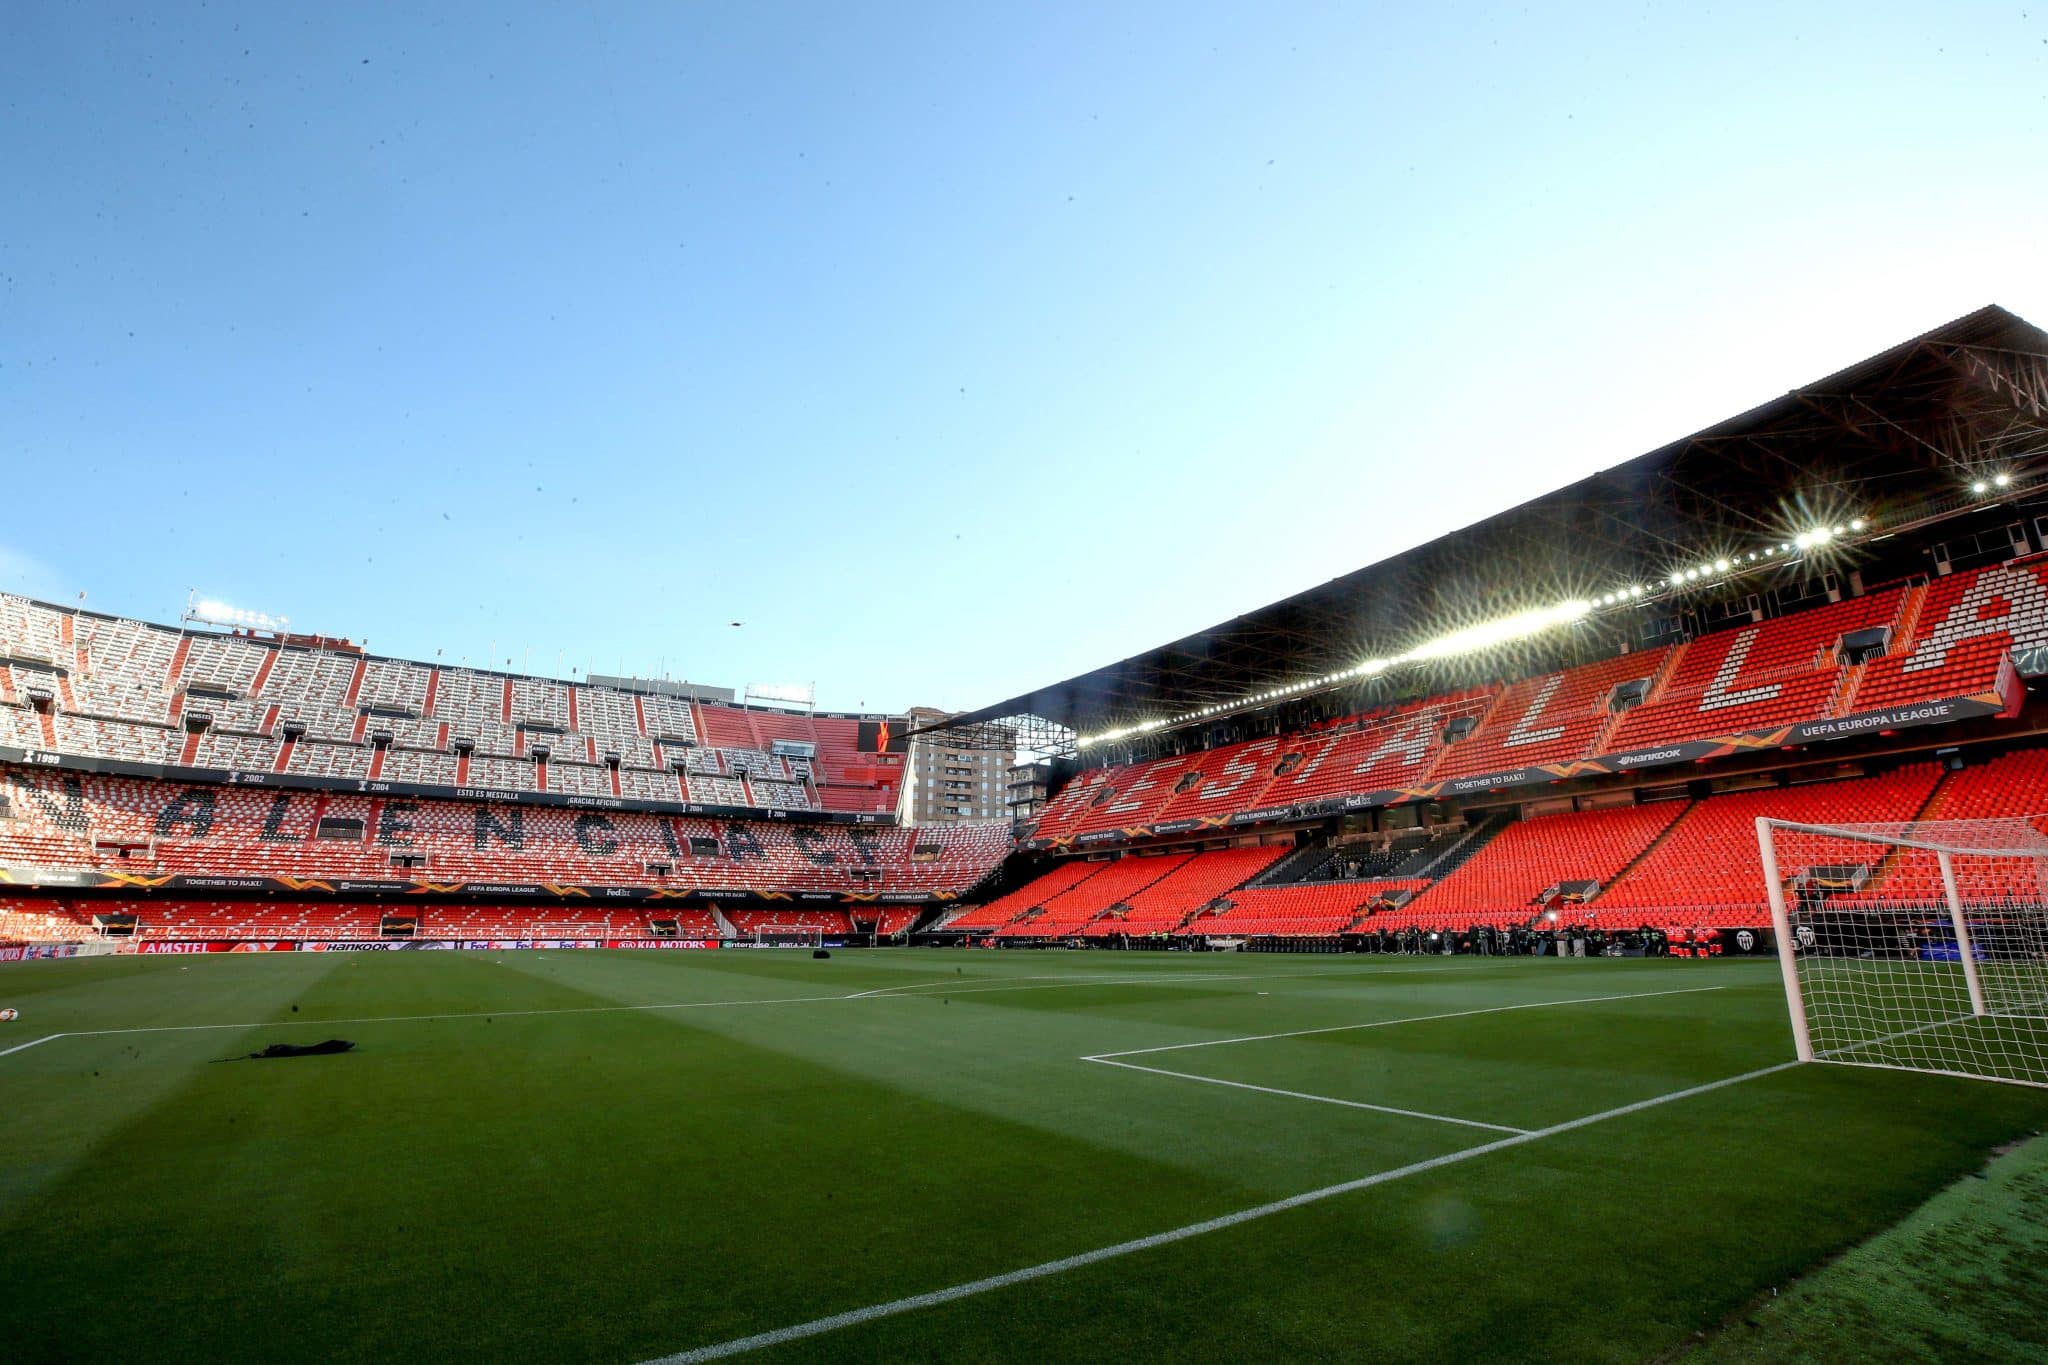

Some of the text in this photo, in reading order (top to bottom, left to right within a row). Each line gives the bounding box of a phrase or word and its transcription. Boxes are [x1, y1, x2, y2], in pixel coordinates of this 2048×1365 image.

[117, 618, 148, 629] AMSTEL
[188, 712, 212, 720] AMSTEL
[1802, 705, 1949, 737] UEFA EUROPA LEAGUE
[36, 753, 60, 764] 1999
[244, 774, 265, 783] 2002
[1454, 772, 1525, 791] TOGETHER TO BAKU
[371, 783, 390, 791] 2004
[475, 790, 485, 798] ES
[486, 791, 519, 800] MESTALLA
[186, 878, 226, 886] TOGETHER
[145, 942, 209, 954] AMSTEL
[471, 941, 502, 950] FedEx
[560, 941, 590, 950] FedEx
[637, 941, 656, 949] KIA
[660, 940, 706, 949] MOTORS
